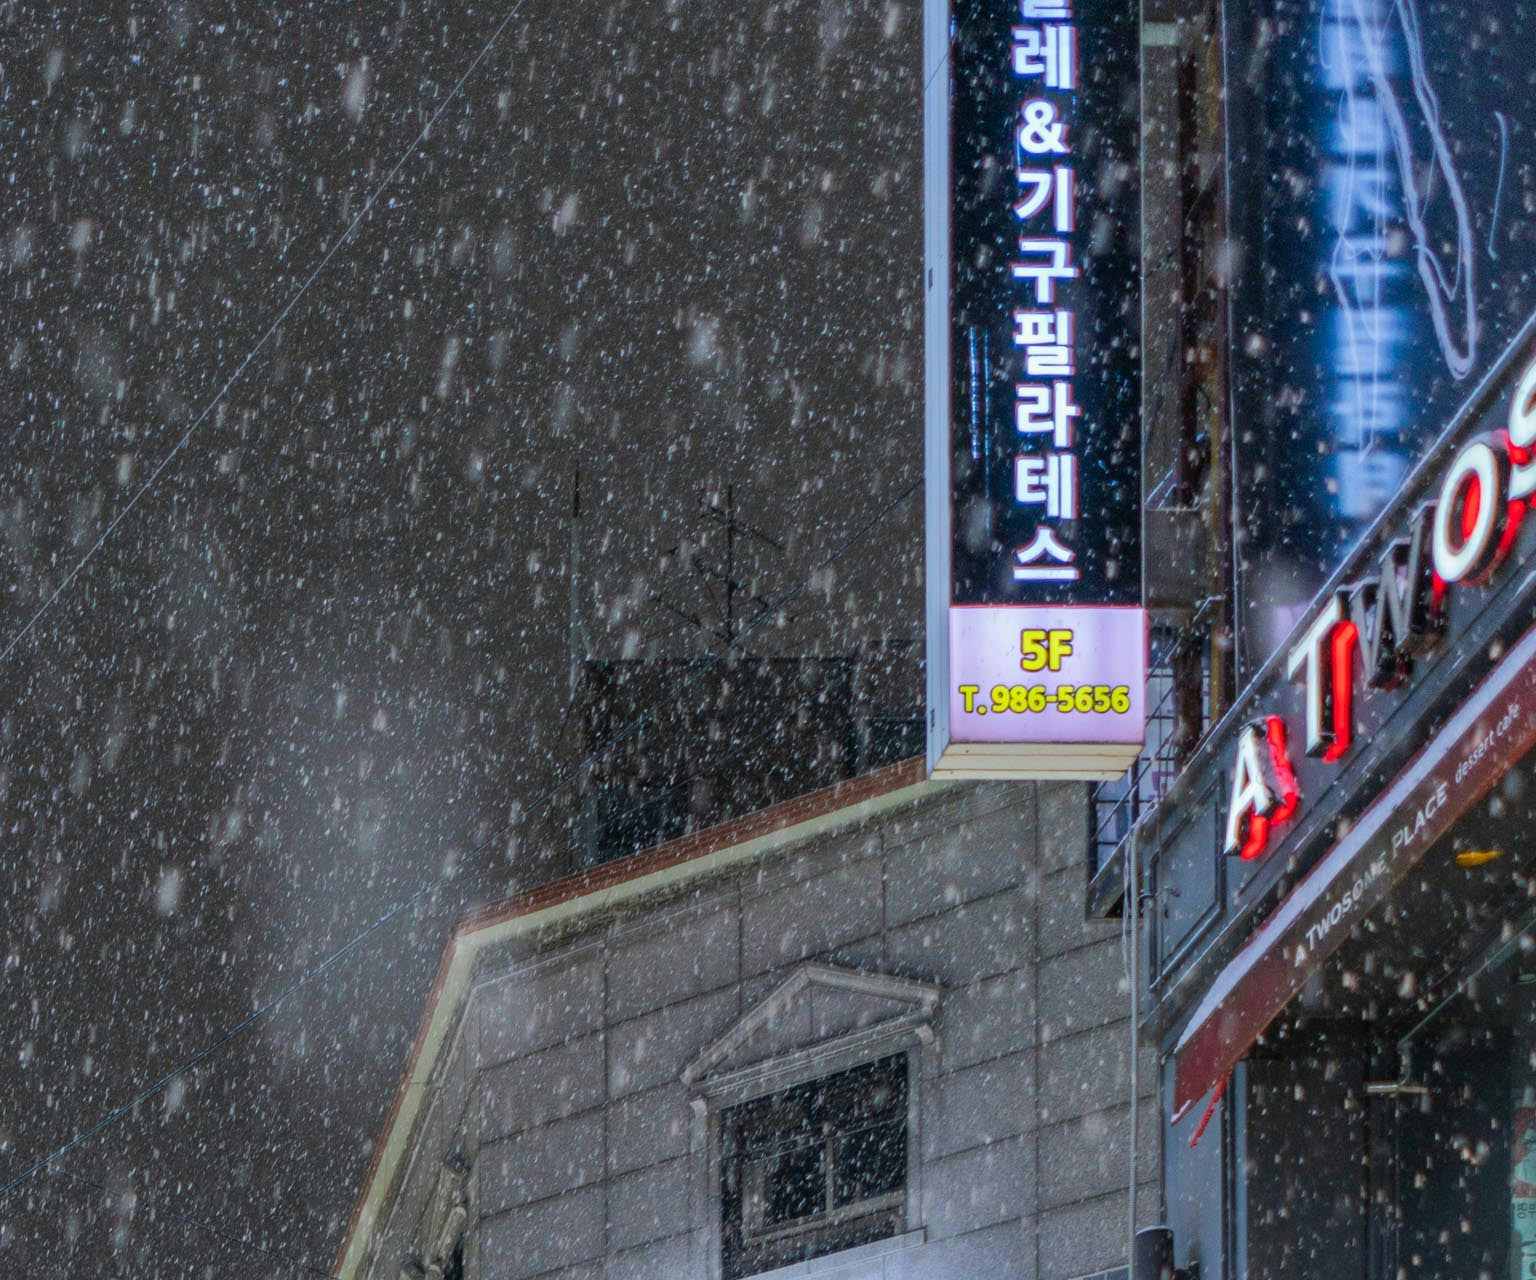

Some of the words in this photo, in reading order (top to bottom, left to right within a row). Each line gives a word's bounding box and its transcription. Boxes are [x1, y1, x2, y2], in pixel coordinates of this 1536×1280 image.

[1020, 630, 1071, 671] 5F
[1224, 720, 1276, 857] A
[1305, 863, 1389, 958] TWOSOME
[1391, 782, 1449, 861] PLACE
[1454, 730, 1496, 783] dessert
